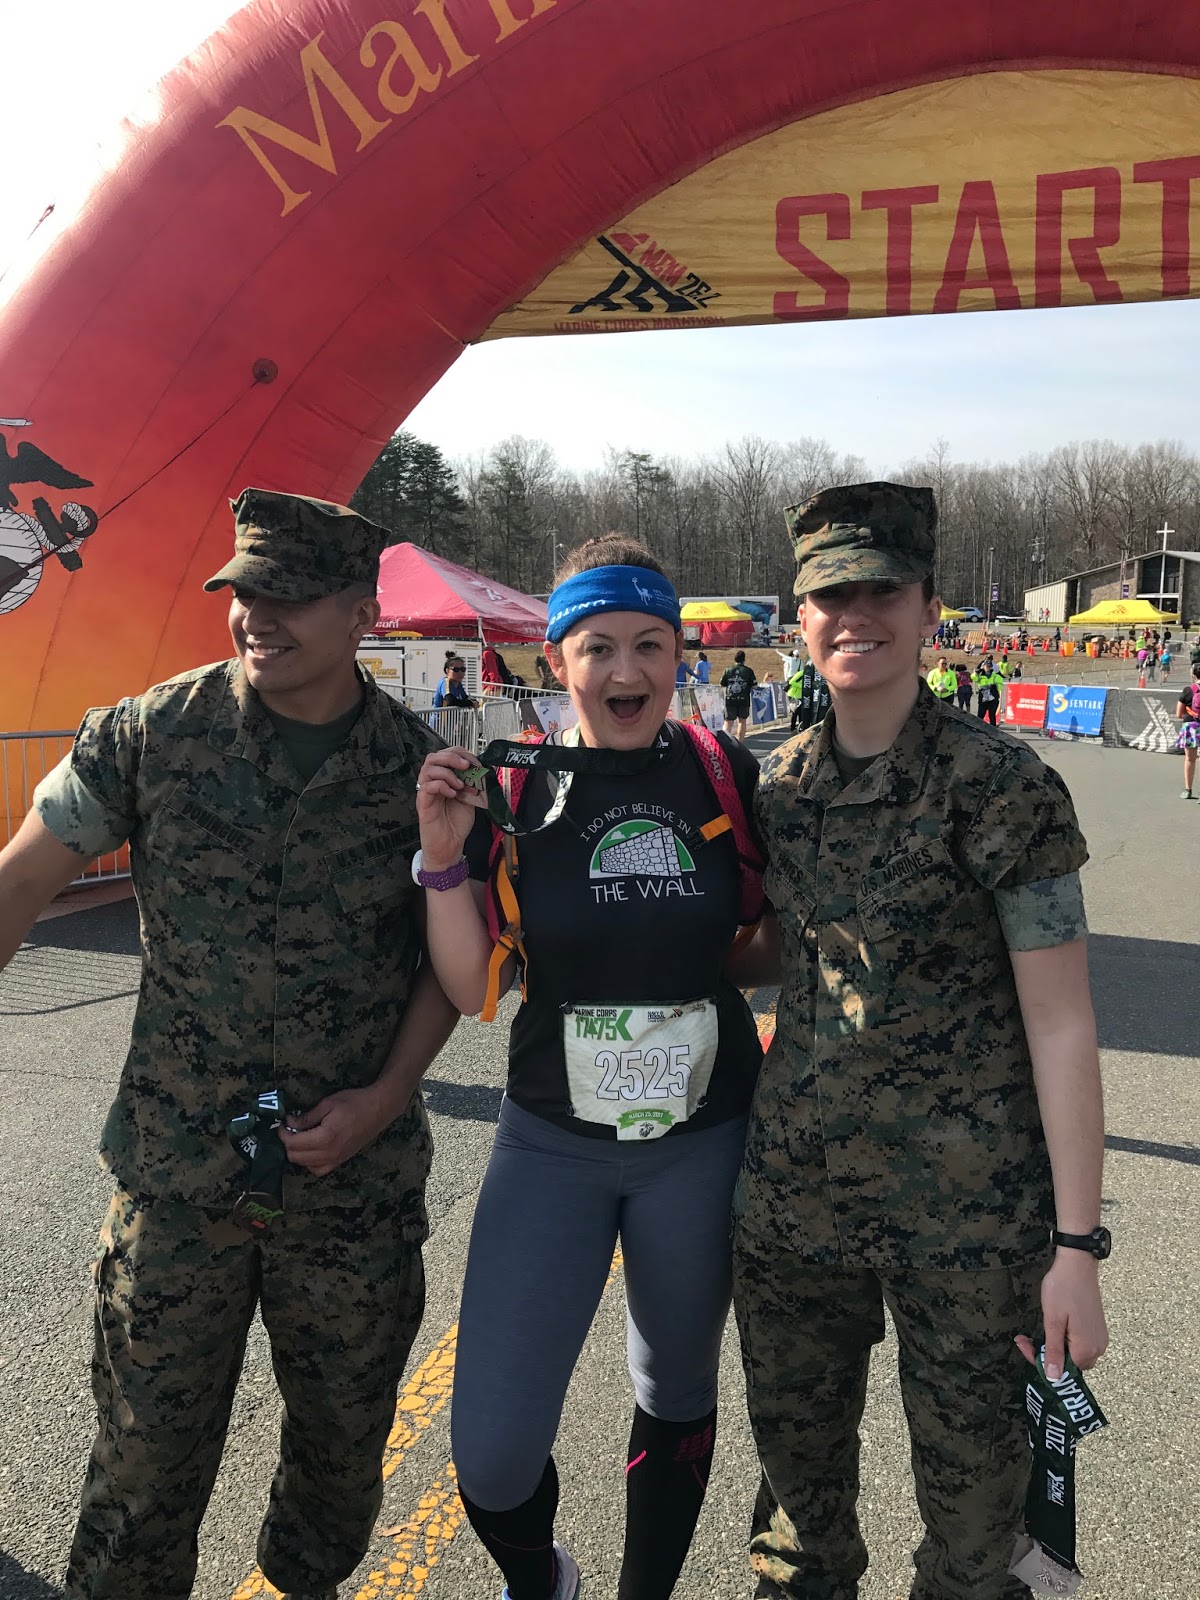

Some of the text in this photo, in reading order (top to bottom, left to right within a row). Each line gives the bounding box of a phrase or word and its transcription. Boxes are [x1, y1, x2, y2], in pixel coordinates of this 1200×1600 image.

[215, 0, 558, 217] Mar
[773, 156, 1200, 322] START
[1069, 699, 1102, 710] SENTARA
[182, 801, 255, 852] DOMINGUEZ
[580, 803, 692, 842] I DO NOT BELIEVE IN
[590, 878, 705, 903] THE WALL
[860, 848, 934, 897] U.S. MARINES
[596, 1009, 617, 1017] CORPS
[595, 1045, 692, 1101] 2525
[1045, 1413, 1067, 1456] 2017
